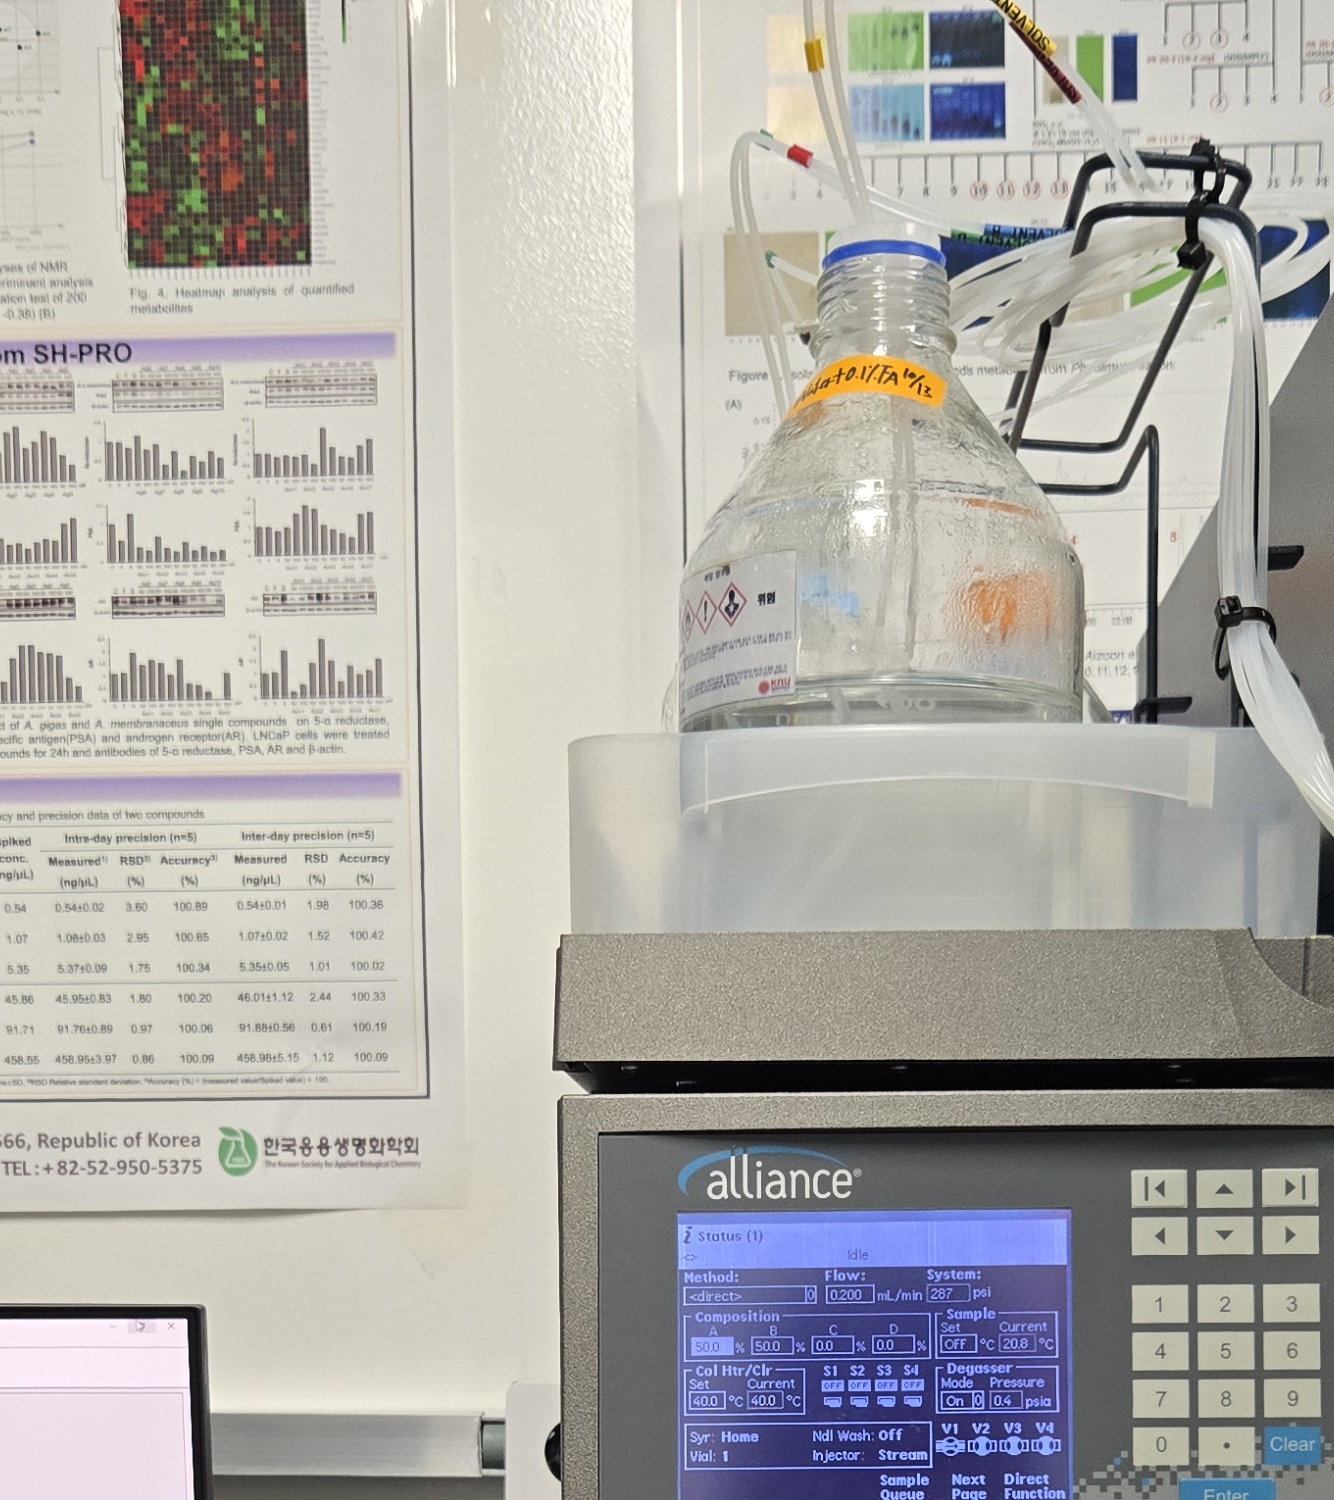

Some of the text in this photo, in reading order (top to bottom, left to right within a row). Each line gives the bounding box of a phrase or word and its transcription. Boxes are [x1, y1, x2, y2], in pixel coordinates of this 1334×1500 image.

[33, 342, 132, 364] SH-PRO
[757, 591, 776, 606] 위험
[241, 830, 375, 843] Inter-day precision (n=5)
[234, 853, 390, 866] Measured RSD Accuracy
[37, 1131, 118, 1151] Republic
[123, 1131, 143, 1149] of
[148, 1131, 202, 1149] Korea
[263, 1136, 420, 1158] 한국응용생명화학회
[1, 1160, 31, 1177] TEL
[707, 1153, 853, 1200] alliance
[698, 1230, 764, 1244] Status (1)
[847, 1248, 869, 1261] Idle
[684, 1271, 740, 1283] Method:
[825, 1270, 866, 1282] Flow:
[926, 1268, 982, 1282] System:
[689, 1289, 742, 1302] <direct>
[830, 1288, 923, 1302] 0.200 mL/min
[930, 1286, 991, 1300] 287 psi
[1154, 1295, 1298, 1313] 1 2 3
[695, 1309, 780, 1325] Composition
[946, 1307, 996, 1321] Sample
[940, 1321, 1048, 1333] Set Current
[695, 1339, 894, 1352] 50.0 50.0 0.0 0.0
[944, 1337, 1029, 1350] OFF 20.8
[1154, 1342, 1299, 1360] 4 5 6
[695, 1364, 771, 1377] Col Htr/Clr
[947, 1362, 1013, 1376] Degasser
[689, 1377, 796, 1390] Set Current
[941, 1376, 1045, 1389] Mode Pressure
[693, 1394, 776, 1407] 40.0 40.0
[946, 1395, 1052, 1409] On 0.4 psia
[1155, 1389, 1299, 1408] 7 8 9
[690, 1427, 904, 1446] Syr: Home Ndl Wash: Off
[1155, 1436, 1168, 1453] 0
[1270, 1436, 1316, 1453] Clear
[690, 1448, 928, 1464] Vial: 1 Injector: Stream
[880, 1472, 930, 1488] Sample
[951, 1473, 986, 1486] Next
[1004, 1472, 1050, 1486] Direct
[880, 1488, 925, 1500] Queue
[1004, 1487, 1066, 1500] Function
